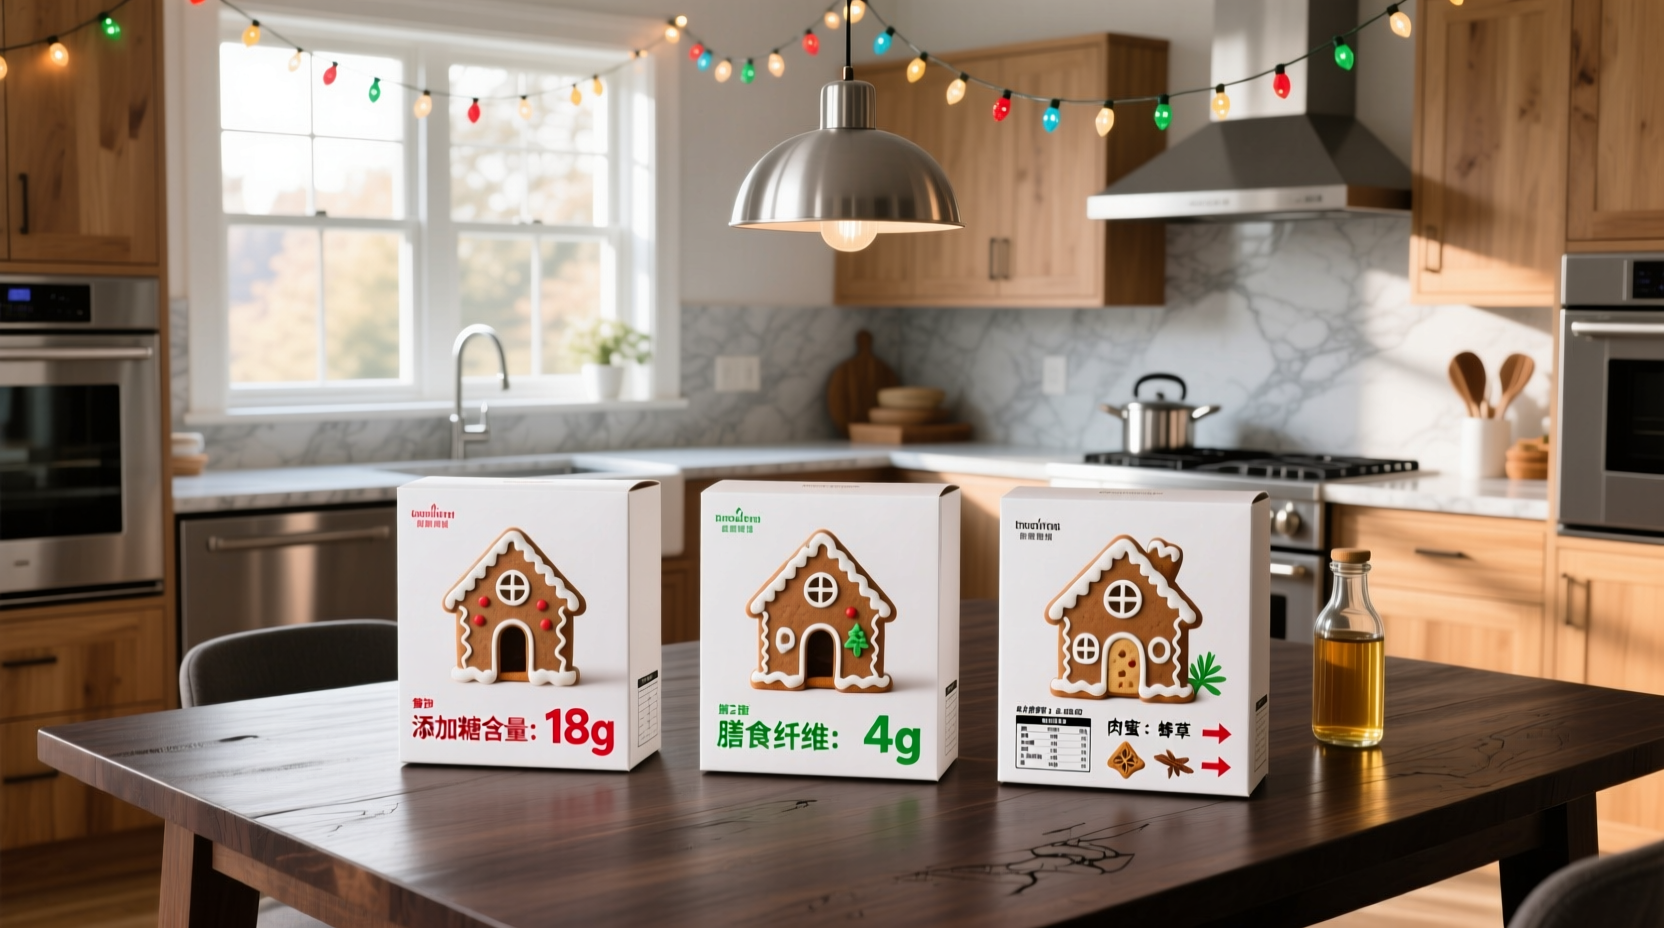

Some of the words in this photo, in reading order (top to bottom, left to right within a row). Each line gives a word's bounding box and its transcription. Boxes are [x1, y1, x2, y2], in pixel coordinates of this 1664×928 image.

[545, 708, 615, 756] 18g
[717, 719, 839, 751] 膳食纤维：
[864, 715, 921, 765] 4g
